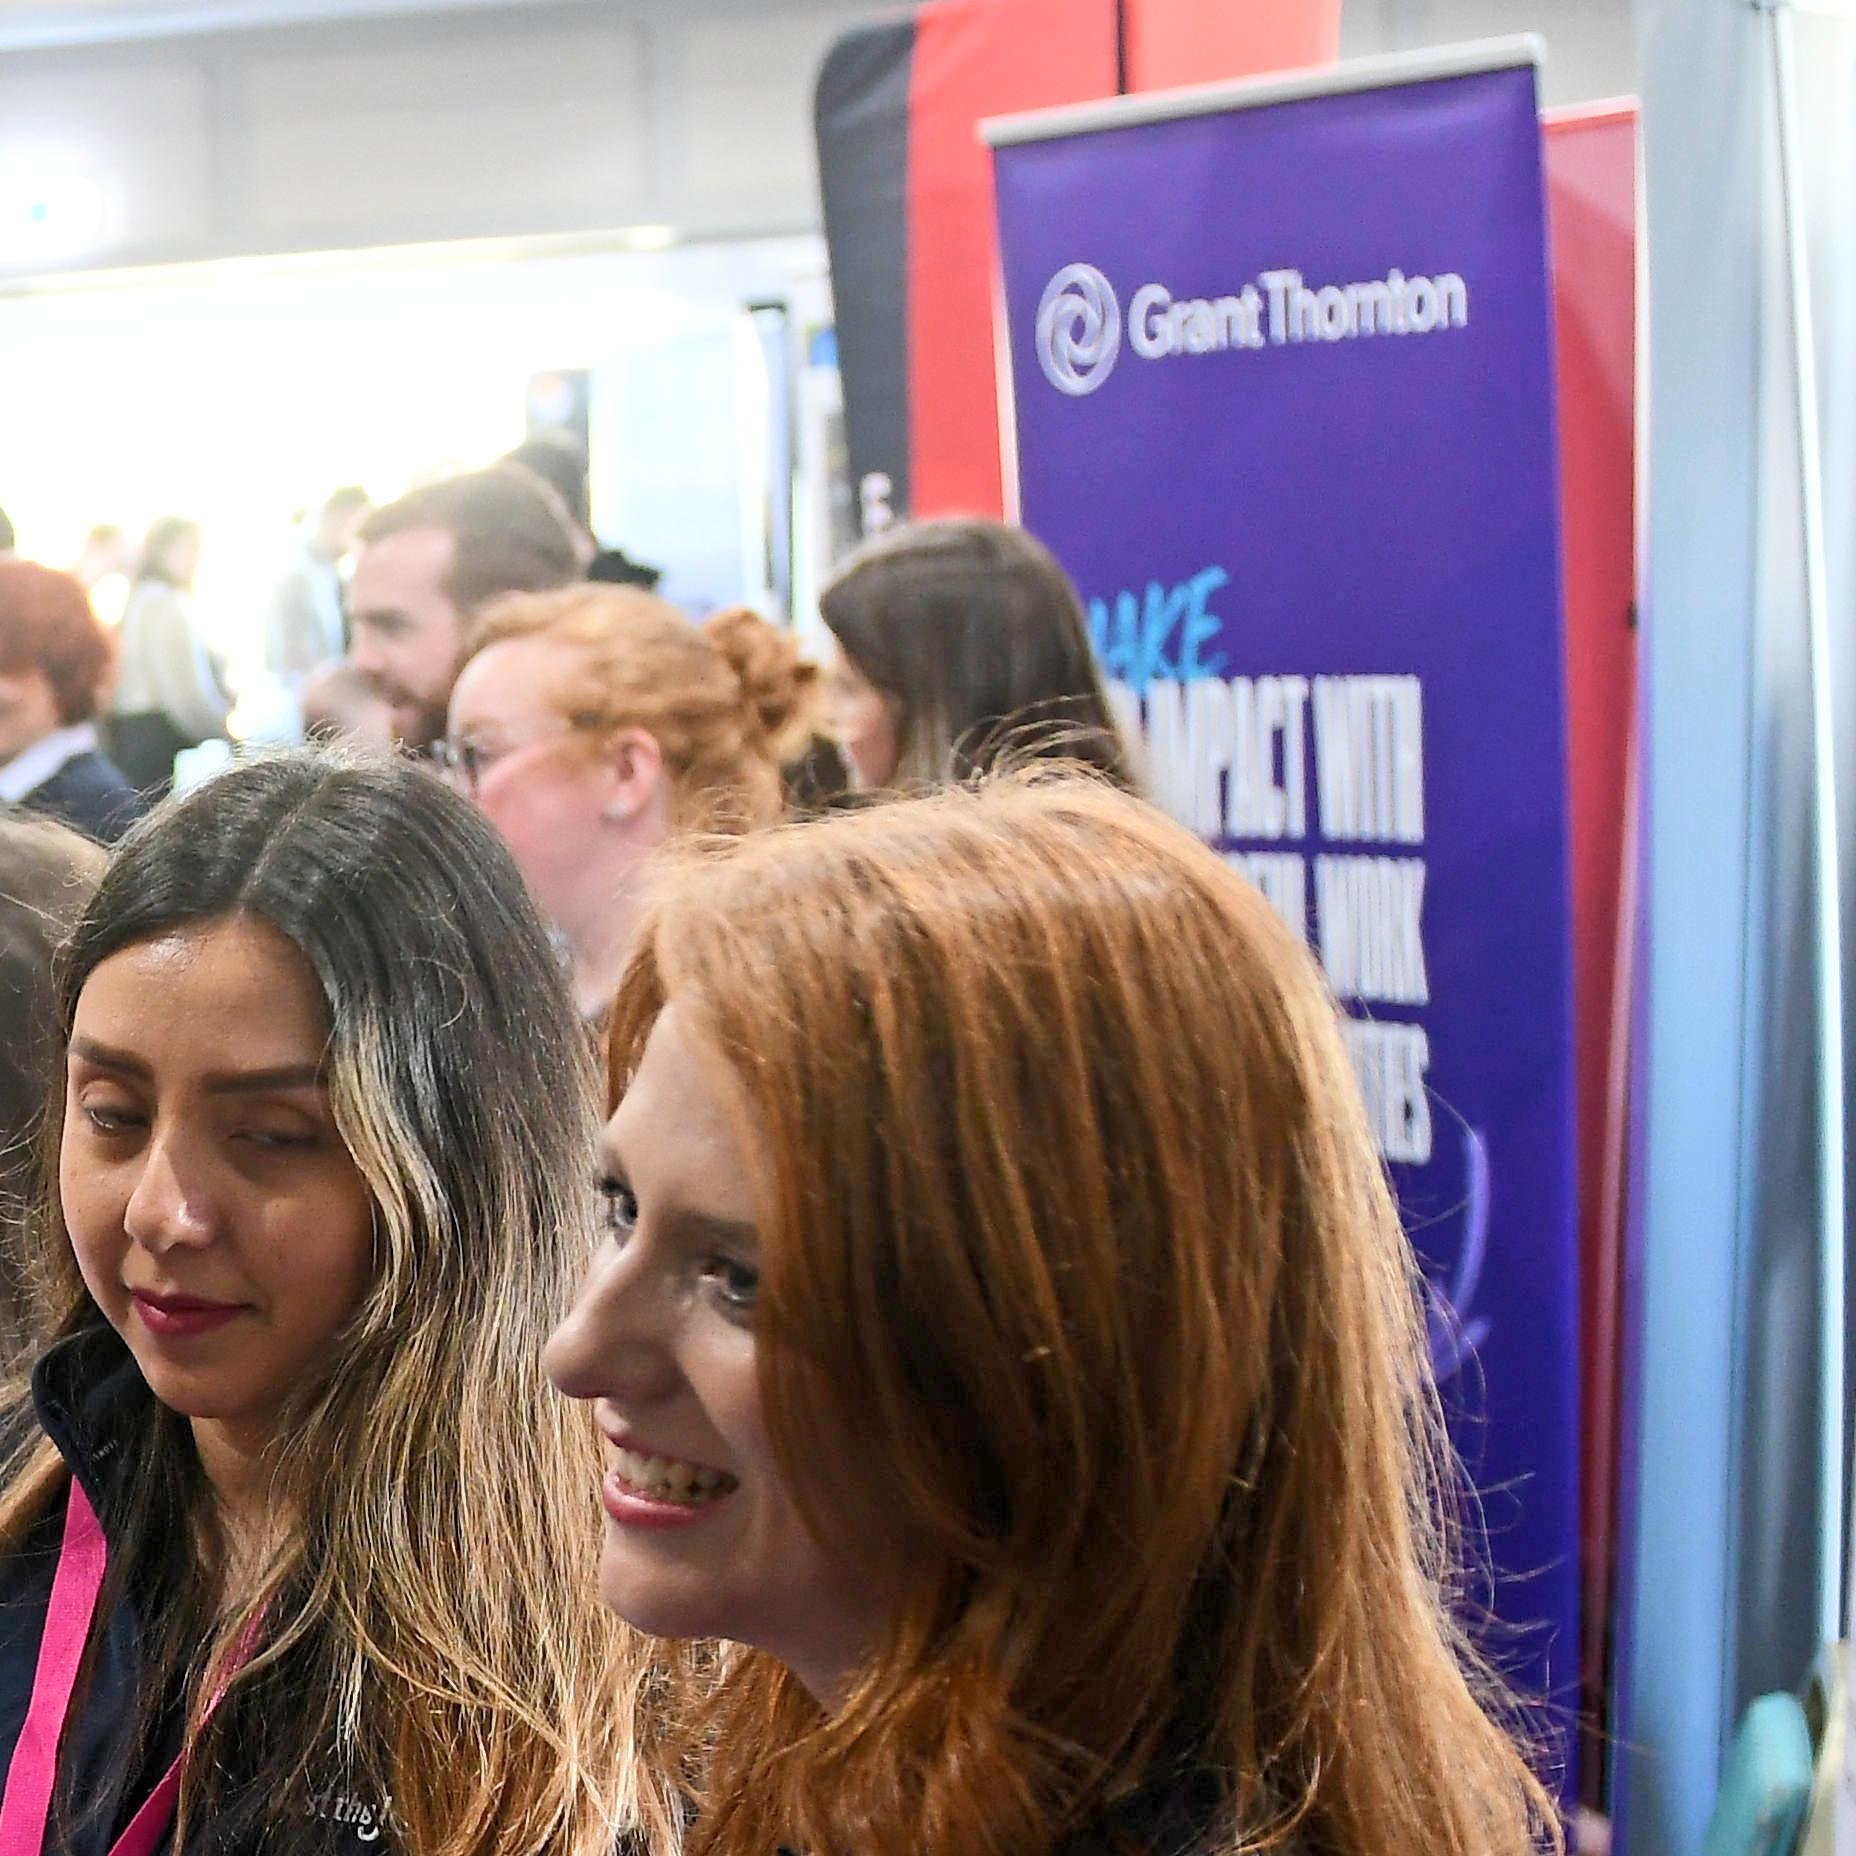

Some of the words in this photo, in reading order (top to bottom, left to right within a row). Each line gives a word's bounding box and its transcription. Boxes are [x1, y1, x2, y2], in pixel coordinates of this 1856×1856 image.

[1127, 282, 1265, 360] Grant
[1257, 267, 1468, 345] Thornton
[1089, 565, 1230, 700] AKE
[1311, 672, 1428, 845] WITH
